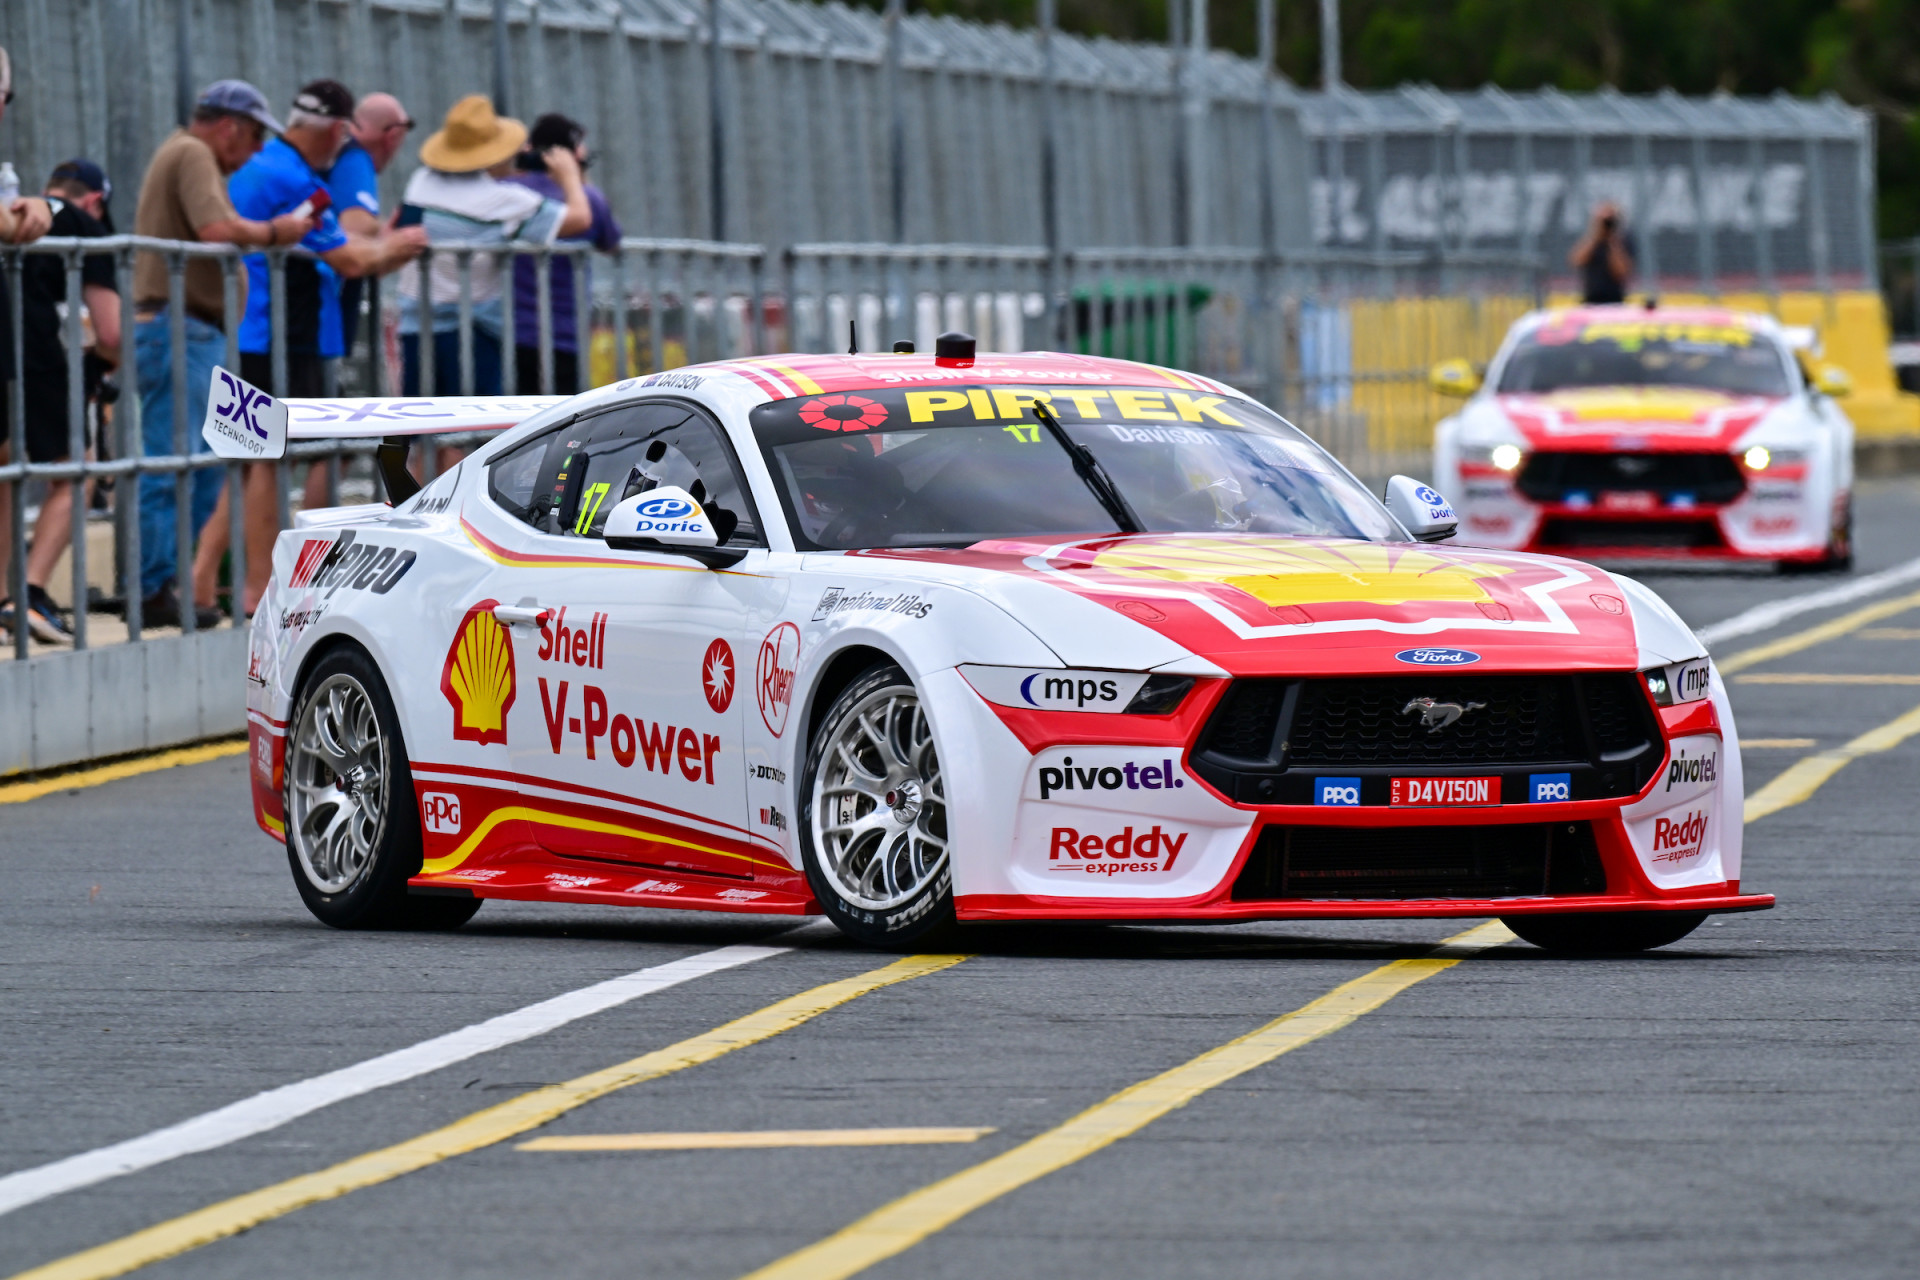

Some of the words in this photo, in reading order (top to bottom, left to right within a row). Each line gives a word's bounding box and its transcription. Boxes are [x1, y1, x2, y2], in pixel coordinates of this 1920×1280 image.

[656, 373, 706, 390] DAVISON
[878, 368, 964, 383] Shell
[975, 368, 1113, 381] V-Power
[216, 371, 272, 440] DXC
[904, 388, 1245, 428] PIRTEK
[213, 418, 266, 456] TECHNOLOGY
[1002, 424, 1042, 443] 17
[1106, 424, 1222, 446] Davison
[574, 482, 611, 535] 17
[636, 520, 703, 533] Doric
[308, 529, 417, 600] Repco
[833, 591, 904, 612] national
[895, 596, 933, 618] tiles
[538, 606, 609, 670] Shell
[1413, 649, 1464, 662] Ford
[762, 626, 795, 717] Rheem
[1687, 665, 1709, 695] mps
[1044, 678, 1118, 707] mps
[538, 677, 721, 785] V-Power
[756, 765, 786, 784] DUNLOP
[1039, 757, 1184, 799] pivotel.
[1666, 749, 1716, 792] pivotel.
[1323, 787, 1359, 804] PPQ
[1537, 782, 1569, 800] PPQ
[425, 796, 460, 829] PPG
[1653, 810, 1708, 855] Reddy
[1049, 825, 1189, 871] Reddy
[1668, 846, 1697, 863] express
[1085, 861, 1158, 876] express
